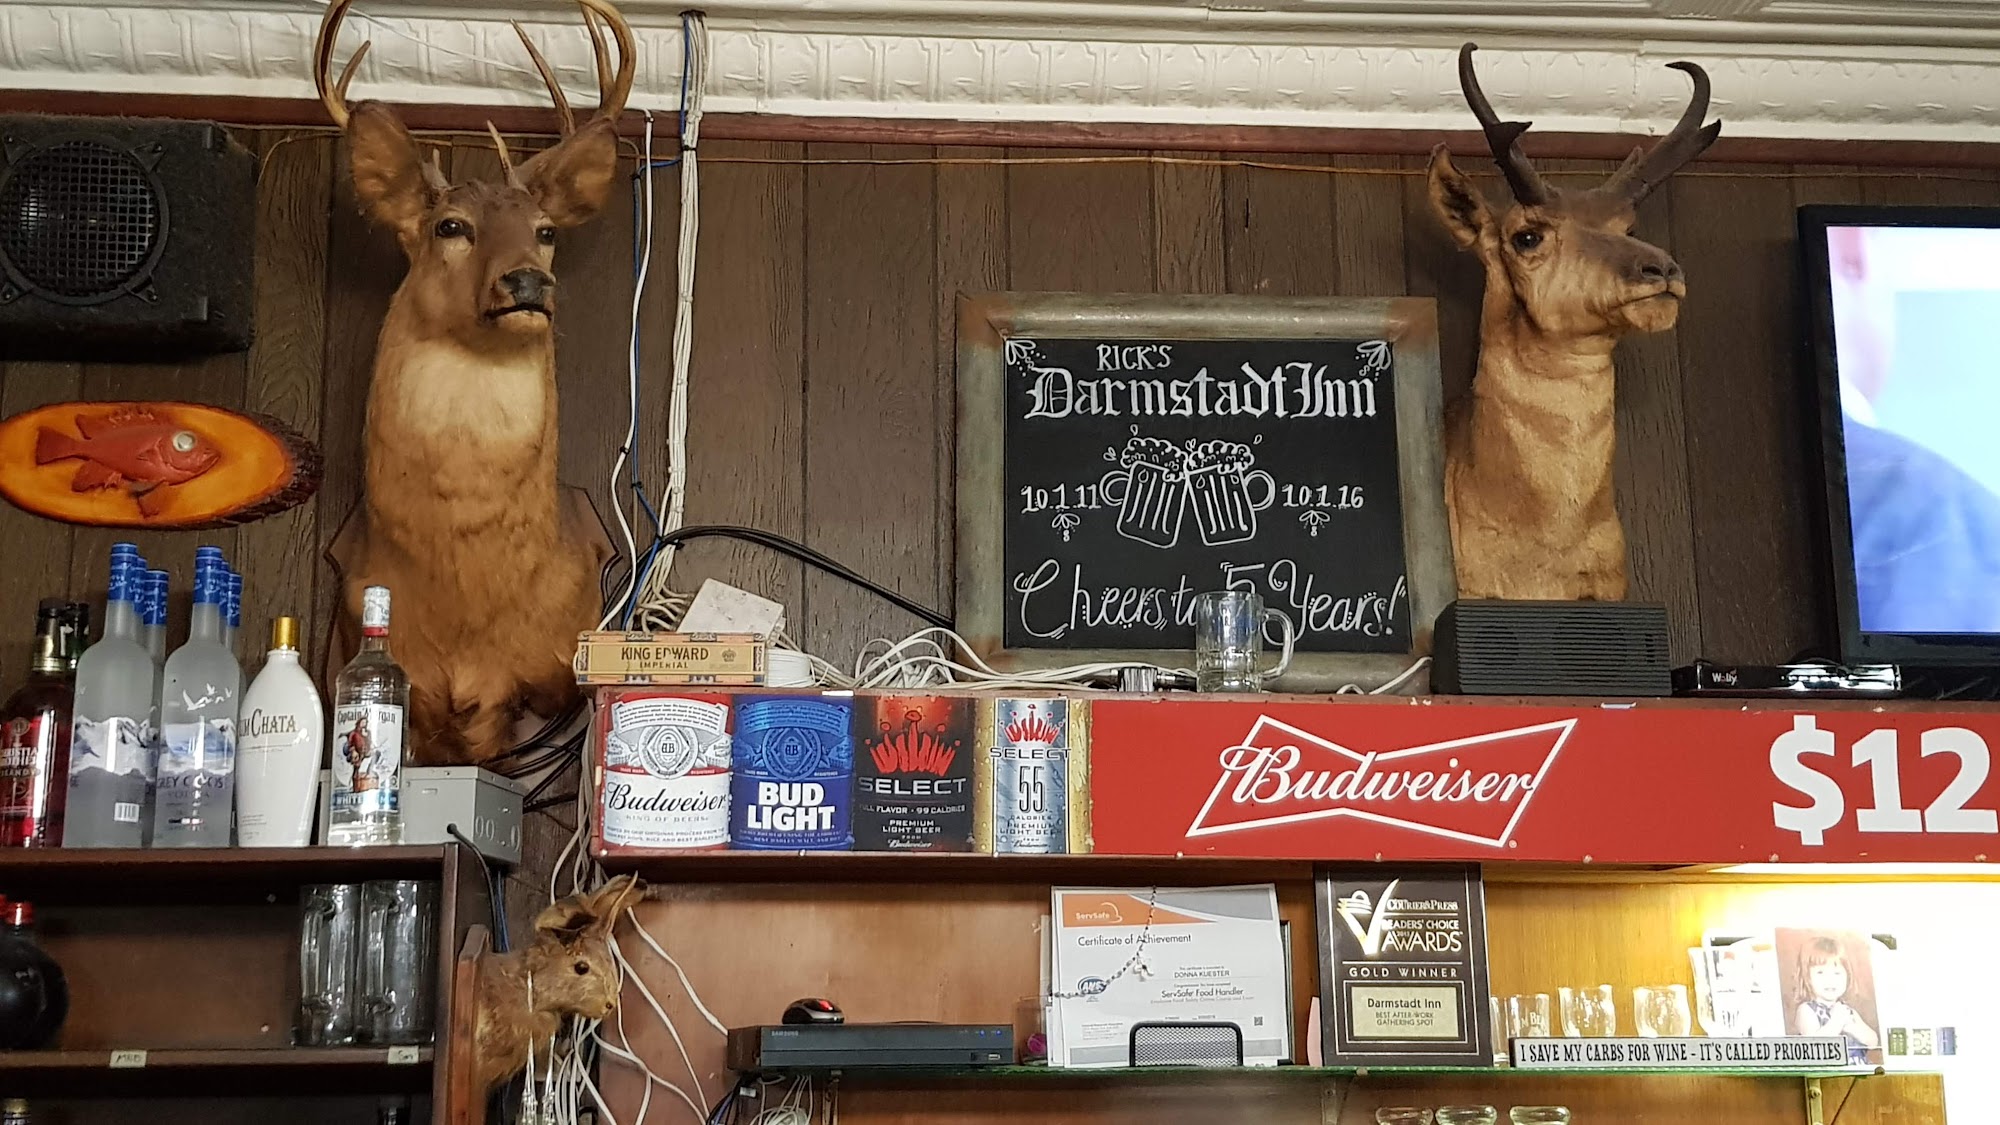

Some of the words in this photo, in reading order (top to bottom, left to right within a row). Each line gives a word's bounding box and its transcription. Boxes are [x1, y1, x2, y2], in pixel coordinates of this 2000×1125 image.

[1096, 344, 1173, 371] RICK'S
[1024, 360, 1288, 420] Darmstadt
[1289, 361, 1378, 420] Inn
[1020, 484, 1101, 514] 10.1.11
[1282, 485, 1364, 509] 10.1.16
[1013, 559, 1167, 639] Cheers
[1268, 559, 1408, 646] Years!
[621, 647, 651, 661] KING
[655, 647, 710, 661] EDWARD
[639, 661, 689, 669] IMPERIAL
[990, 747, 1072, 759] SELECT
[1219, 745, 1536, 804] Budweiser
[1769, 714, 1999, 846] $12
[758, 781, 824, 807] BUD
[858, 777, 967, 795] SELECT
[1019, 766, 1046, 813] 55
[607, 782, 727, 812] Budweiser
[747, 804, 836, 831] LIGHT
[876, 805, 908, 814] FLAVOR
[1076, 911, 1110, 921] ServSafe
[1426, 919, 1460, 930] CHOICE
[1078, 934, 1122, 947] Certificate
[1125, 933, 1133, 945] of
[1381, 930, 1463, 952] AWARDS
[1349, 967, 1390, 978] GOLD
[1399, 967, 1458, 978] WINNER
[1196, 988, 1214, 997] Food
[1215, 987, 1244, 996] Handler
[1367, 998, 1421, 1008] Darmstadt
[1425, 998, 1442, 1009] Inn
[1521, 1044, 1527, 1062] I
[1530, 1044, 1560, 1062] SAVE
[1563, 1044, 1582, 1062] MY
[1586, 1043, 1624, 1062] CARBS
[1628, 1043, 1651, 1061] FOR
[1653, 1043, 1688, 1062] WINE
[1700, 1042, 1723, 1061] IT'S
[1726, 1042, 1770, 1061] CALLED
[1774, 1042, 1842, 1061] PRIORITIES
